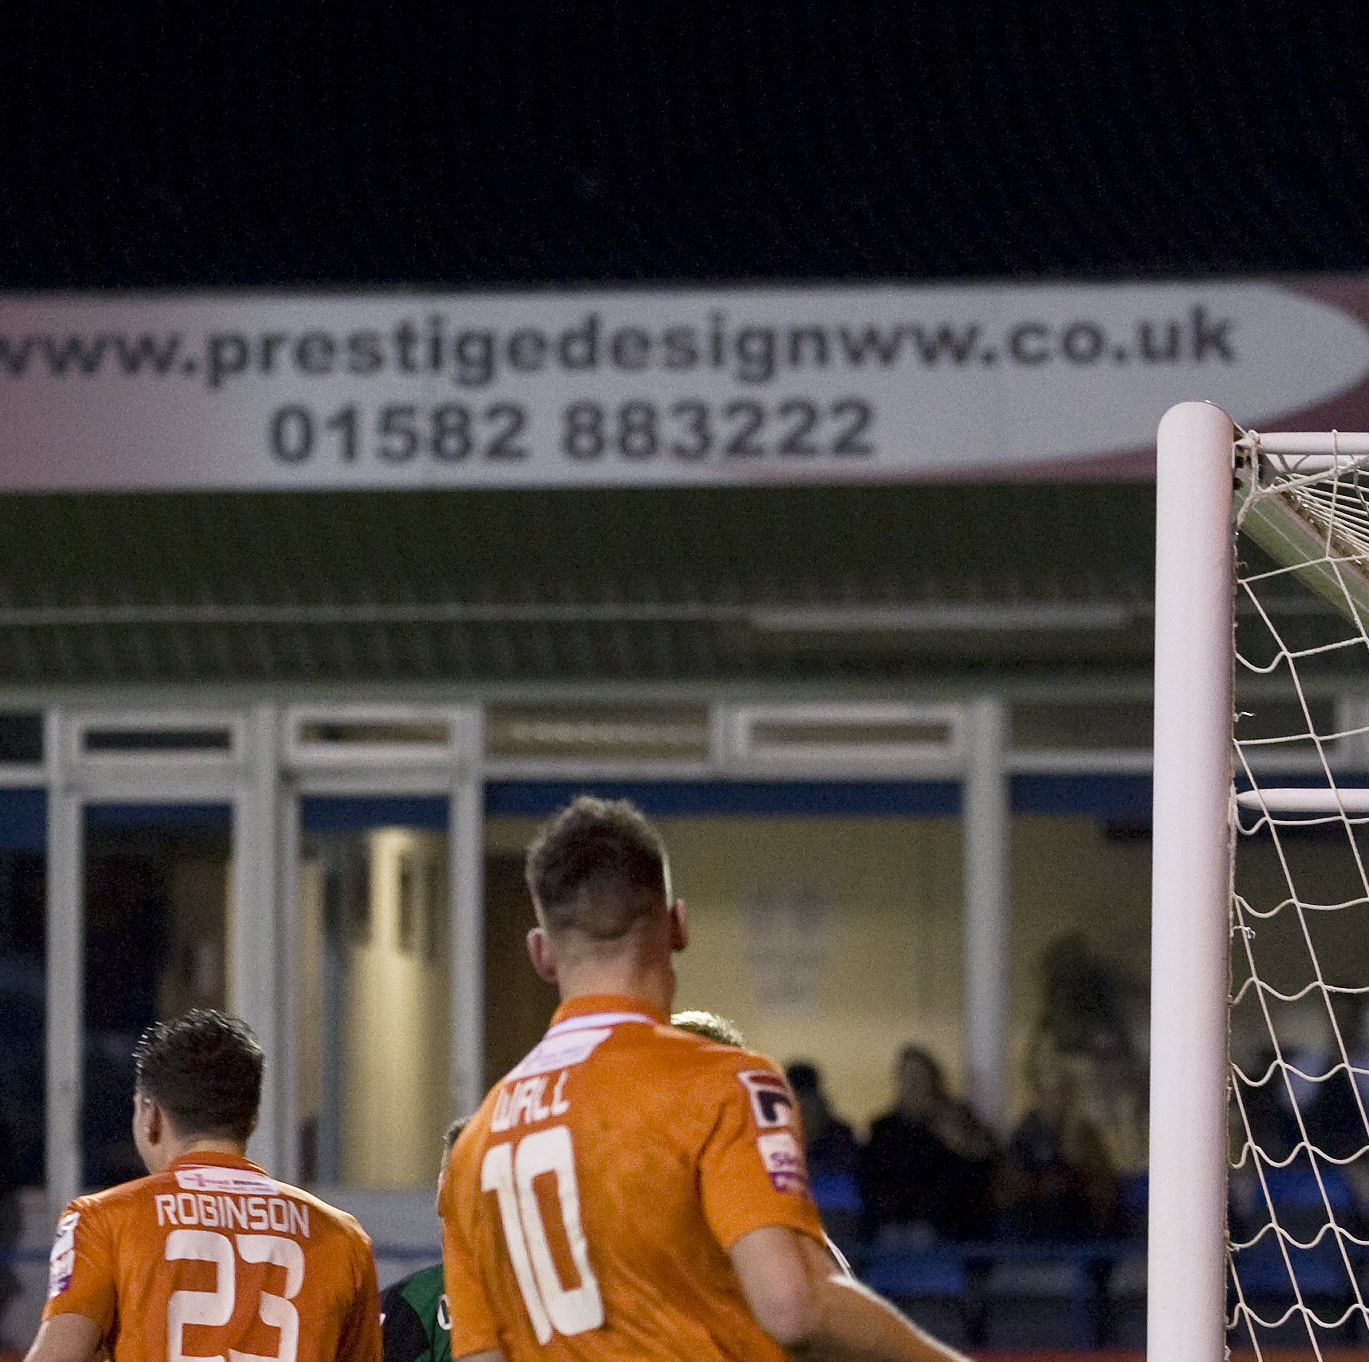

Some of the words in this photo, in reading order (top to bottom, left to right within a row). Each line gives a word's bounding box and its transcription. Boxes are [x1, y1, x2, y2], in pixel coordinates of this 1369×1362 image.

[269, 396, 529, 463] 01582
[560, 396, 877, 461] 883222
[155, 1193, 310, 1239] ROBINSON
[481, 1124, 605, 1346] 10
